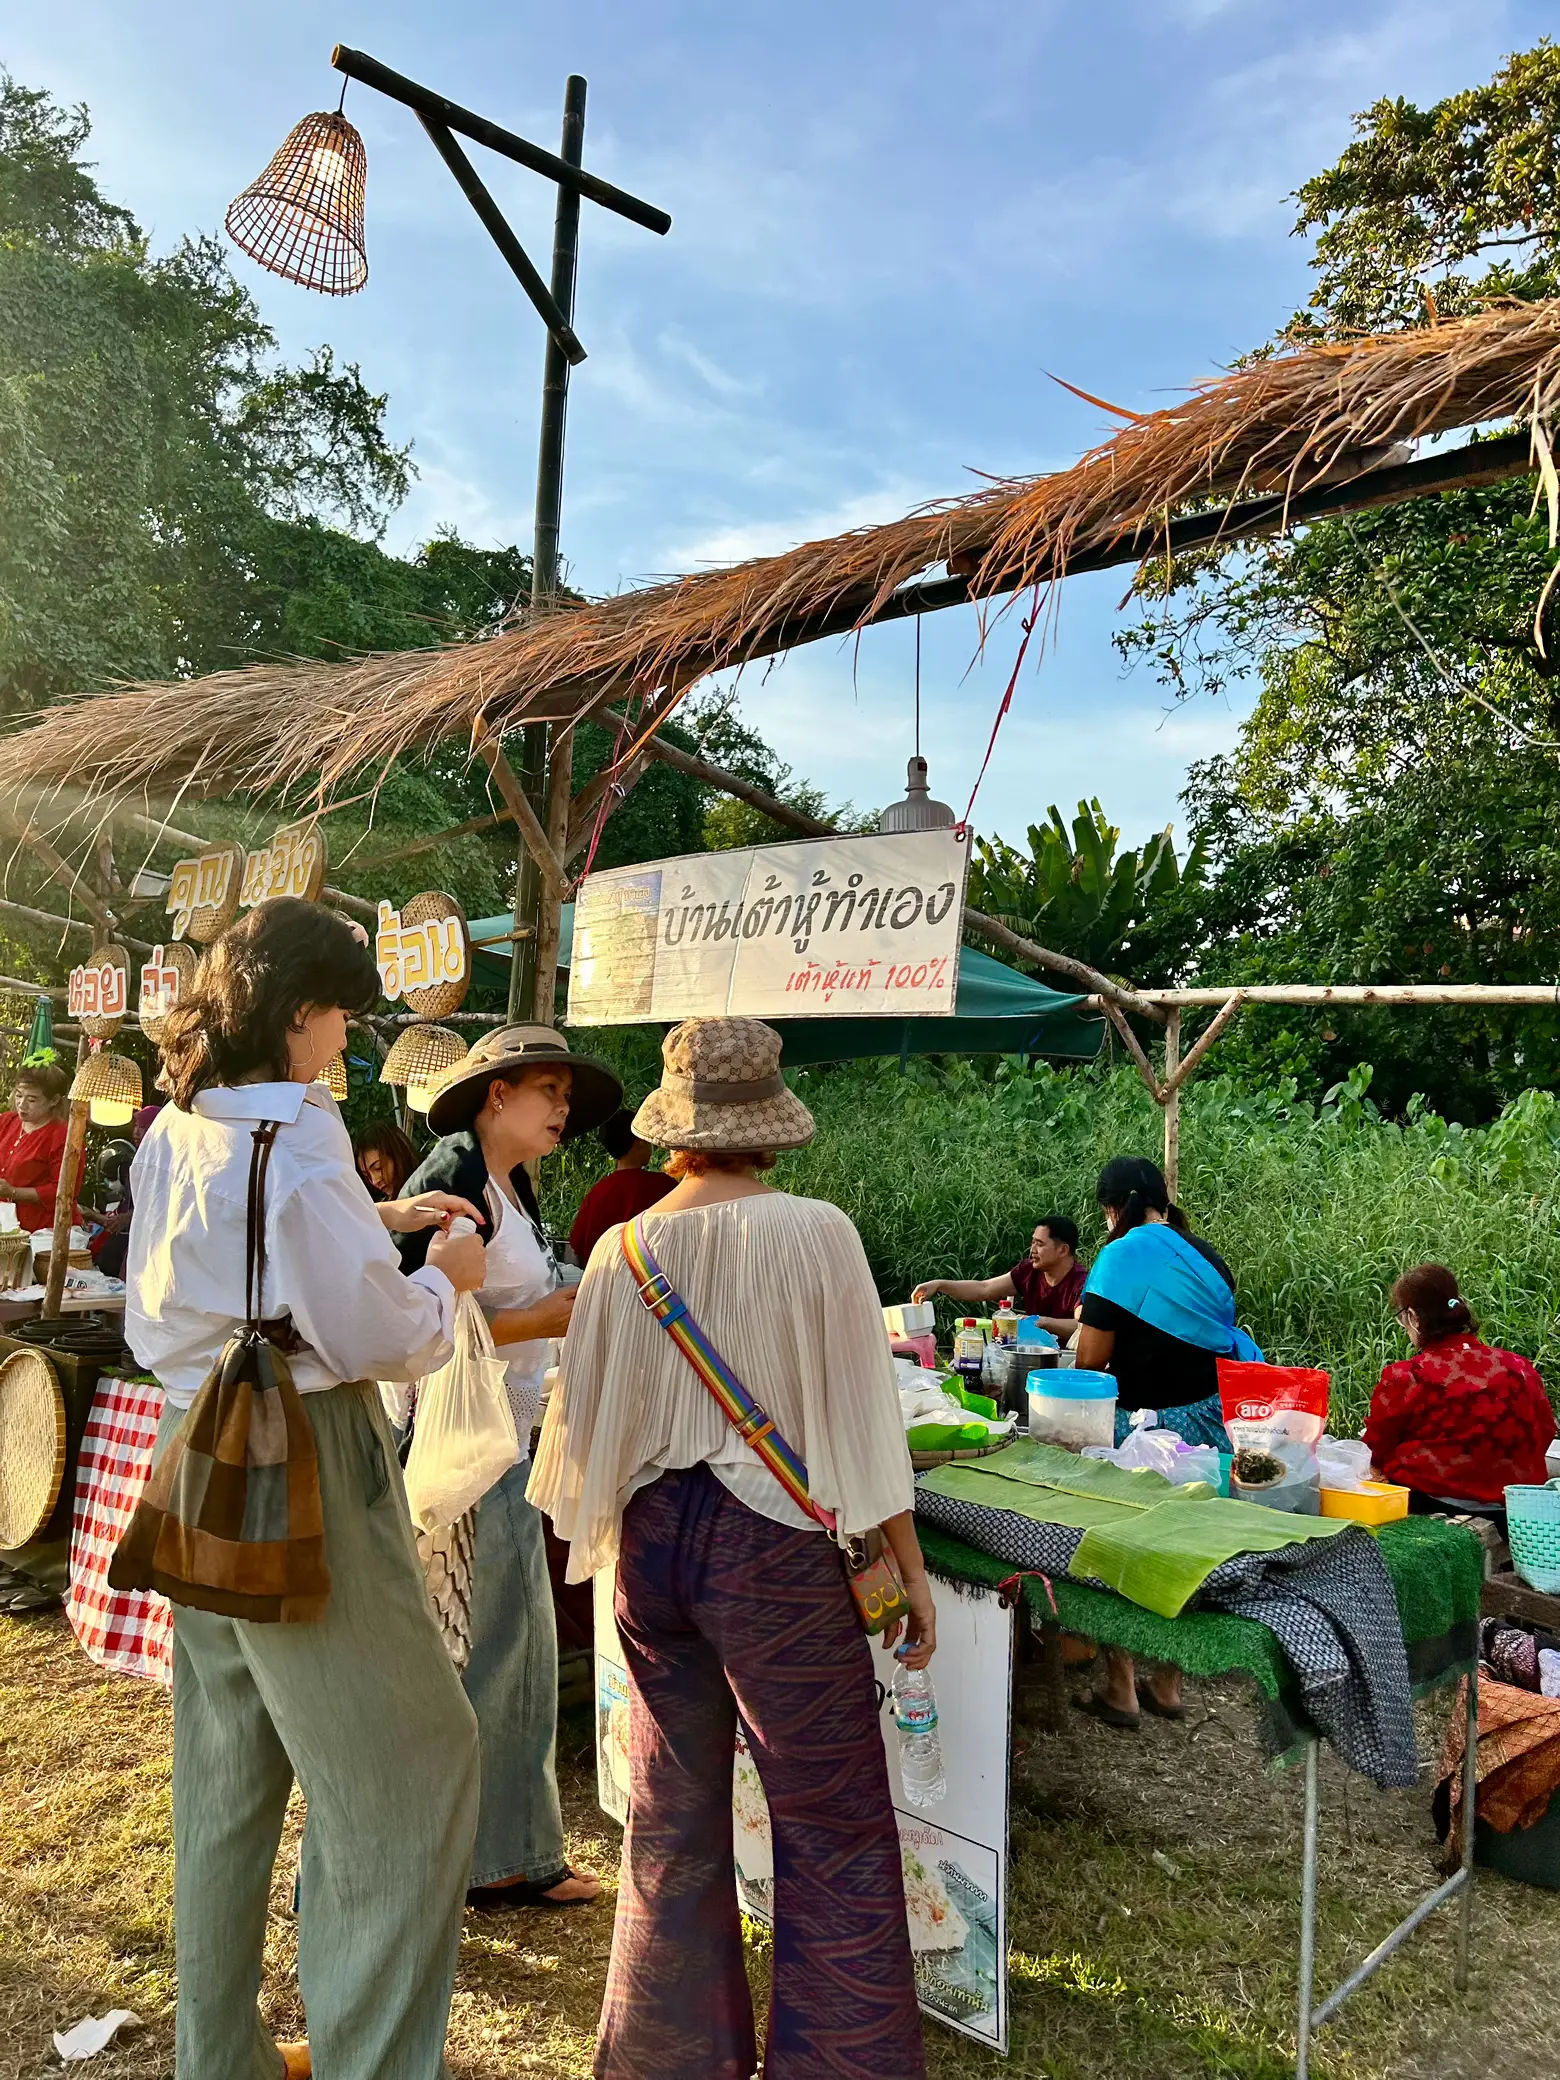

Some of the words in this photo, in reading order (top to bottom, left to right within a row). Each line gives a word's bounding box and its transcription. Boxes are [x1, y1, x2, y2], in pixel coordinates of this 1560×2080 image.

[664, 869, 956, 955] บ้านเต้าหู้ทำเอง
[884, 954, 949, 991] 100%
[1240, 1403, 1270, 1418] aro
